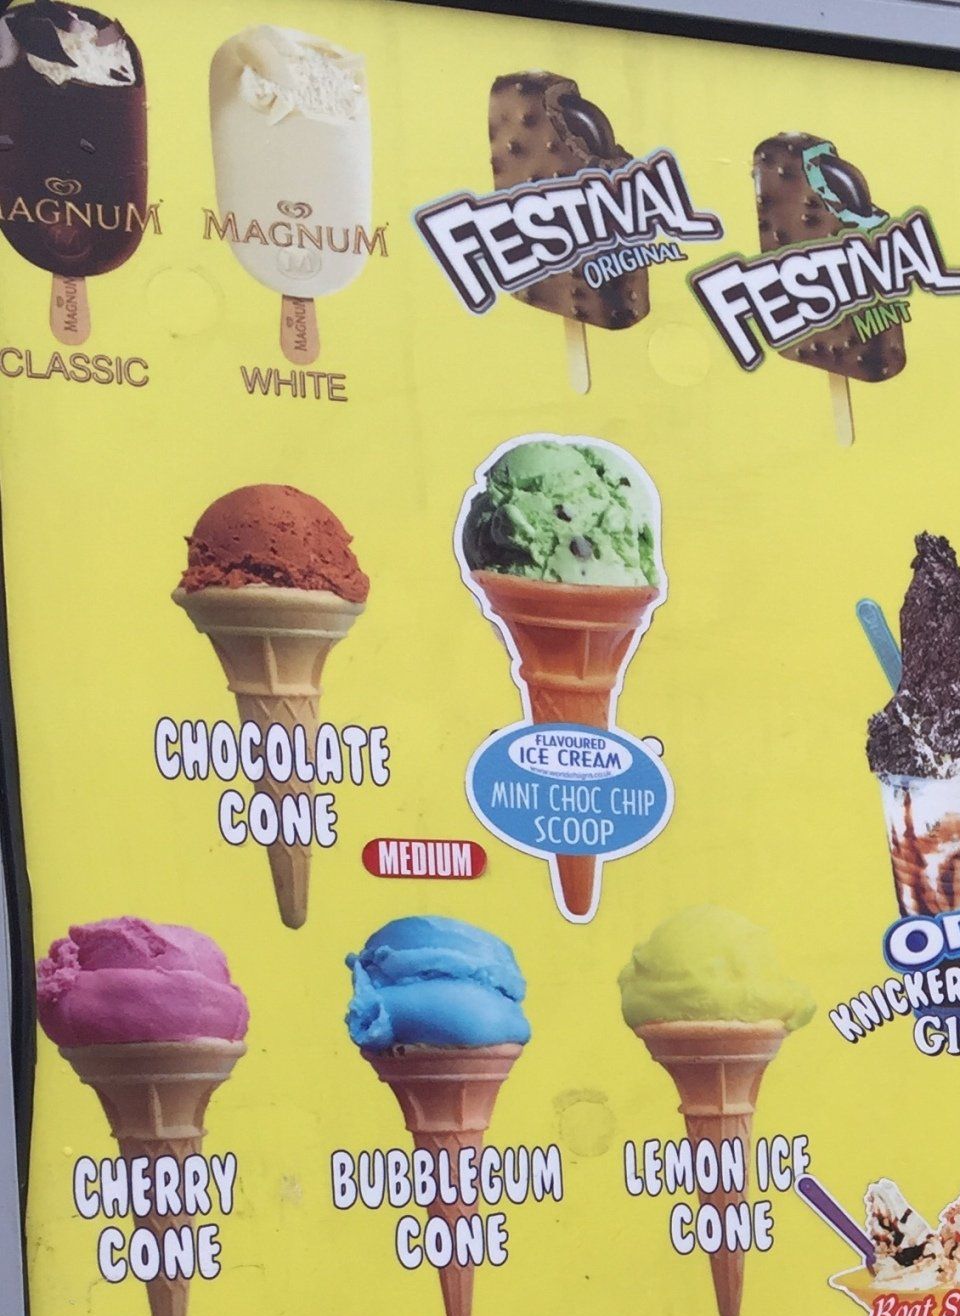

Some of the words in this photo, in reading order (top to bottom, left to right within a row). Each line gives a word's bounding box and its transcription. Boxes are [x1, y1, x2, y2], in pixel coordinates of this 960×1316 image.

[0, 197, 163, 235] AGNUM
[202, 208, 388, 257] MAGNUM
[418, 154, 720, 308] FESTIVAL
[584, 242, 686, 289] ORIGINAL
[853, 301, 910, 344] MINT
[0, 347, 149, 387] CLASSIC
[240, 366, 348, 402] WHITE
[155, 717, 391, 786] CHOCOLATE
[519, 747, 549, 765] ICE
[558, 749, 622, 770] CREAM
[535, 734, 606, 750] FLAVOURED
[218, 789, 338, 848] CONE
[491, 781, 540, 810] MINT
[550, 784, 601, 814] CHOC
[610, 788, 655, 816] CHIP
[534, 816, 614, 846] SCOOP
[378, 841, 473, 877] MEDIUM
[72, 1152, 237, 1219] CHERRY
[330, 1144, 564, 1211] BUBBLEGUM
[623, 1135, 751, 1197] LEMON
[756, 1134, 811, 1192] ICE
[395, 1211, 509, 1270] CONE
[669, 1201, 774, 1256] CONE
[97, 1223, 222, 1284] CONE
